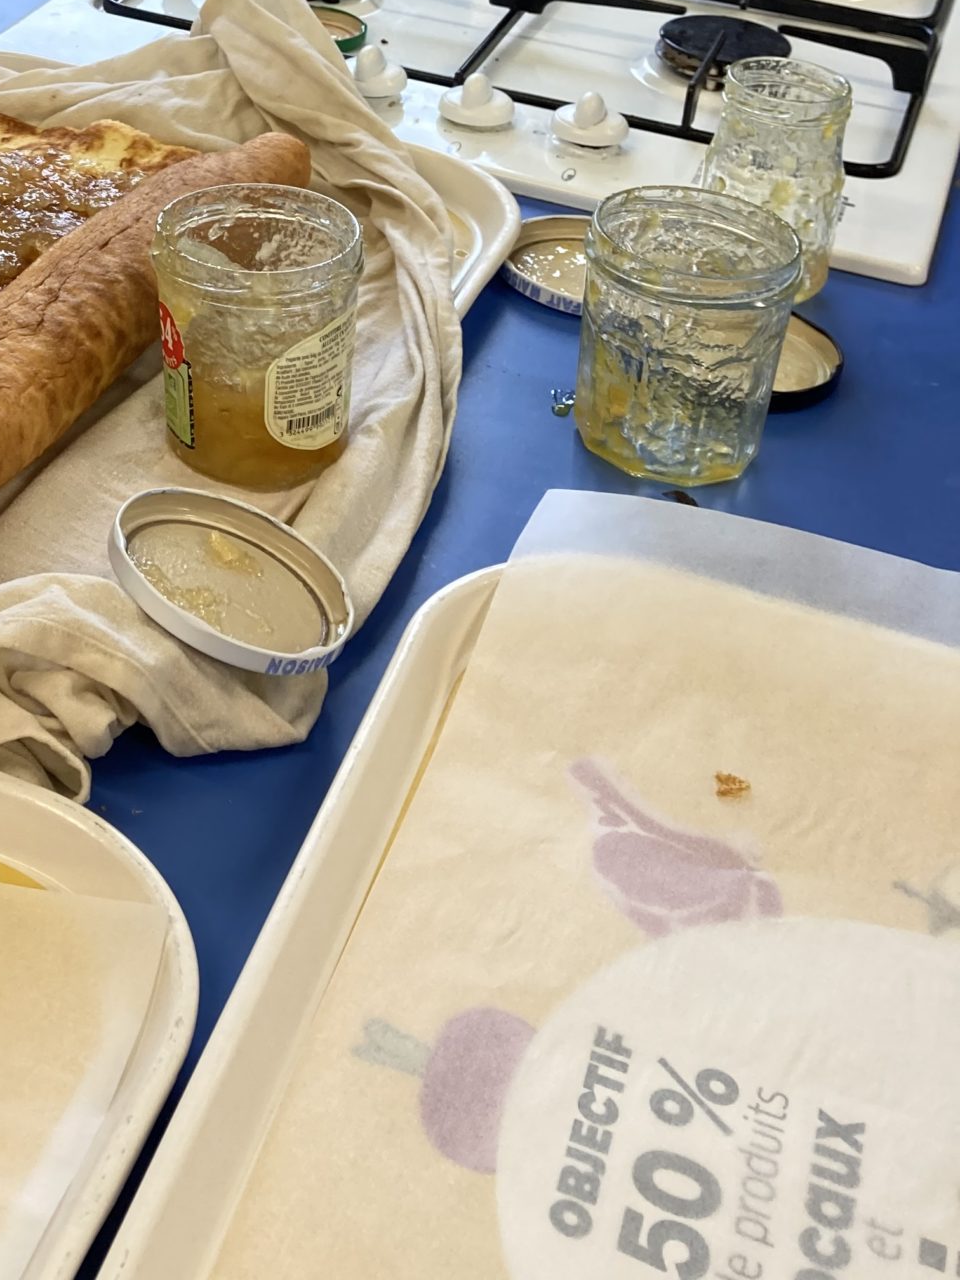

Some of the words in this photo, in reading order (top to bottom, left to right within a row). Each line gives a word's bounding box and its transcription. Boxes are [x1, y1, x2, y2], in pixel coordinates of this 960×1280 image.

[265, 650, 336, 677] MAISON
[549, 1025, 634, 1240] OBJECTIF
[649, 1056, 740, 1136] %
[617, 1149, 723, 1280] 50
[735, 1086, 790, 1248] produits
[793, 1108, 867, 1280] caux
[864, 1217, 906, 1262] et
